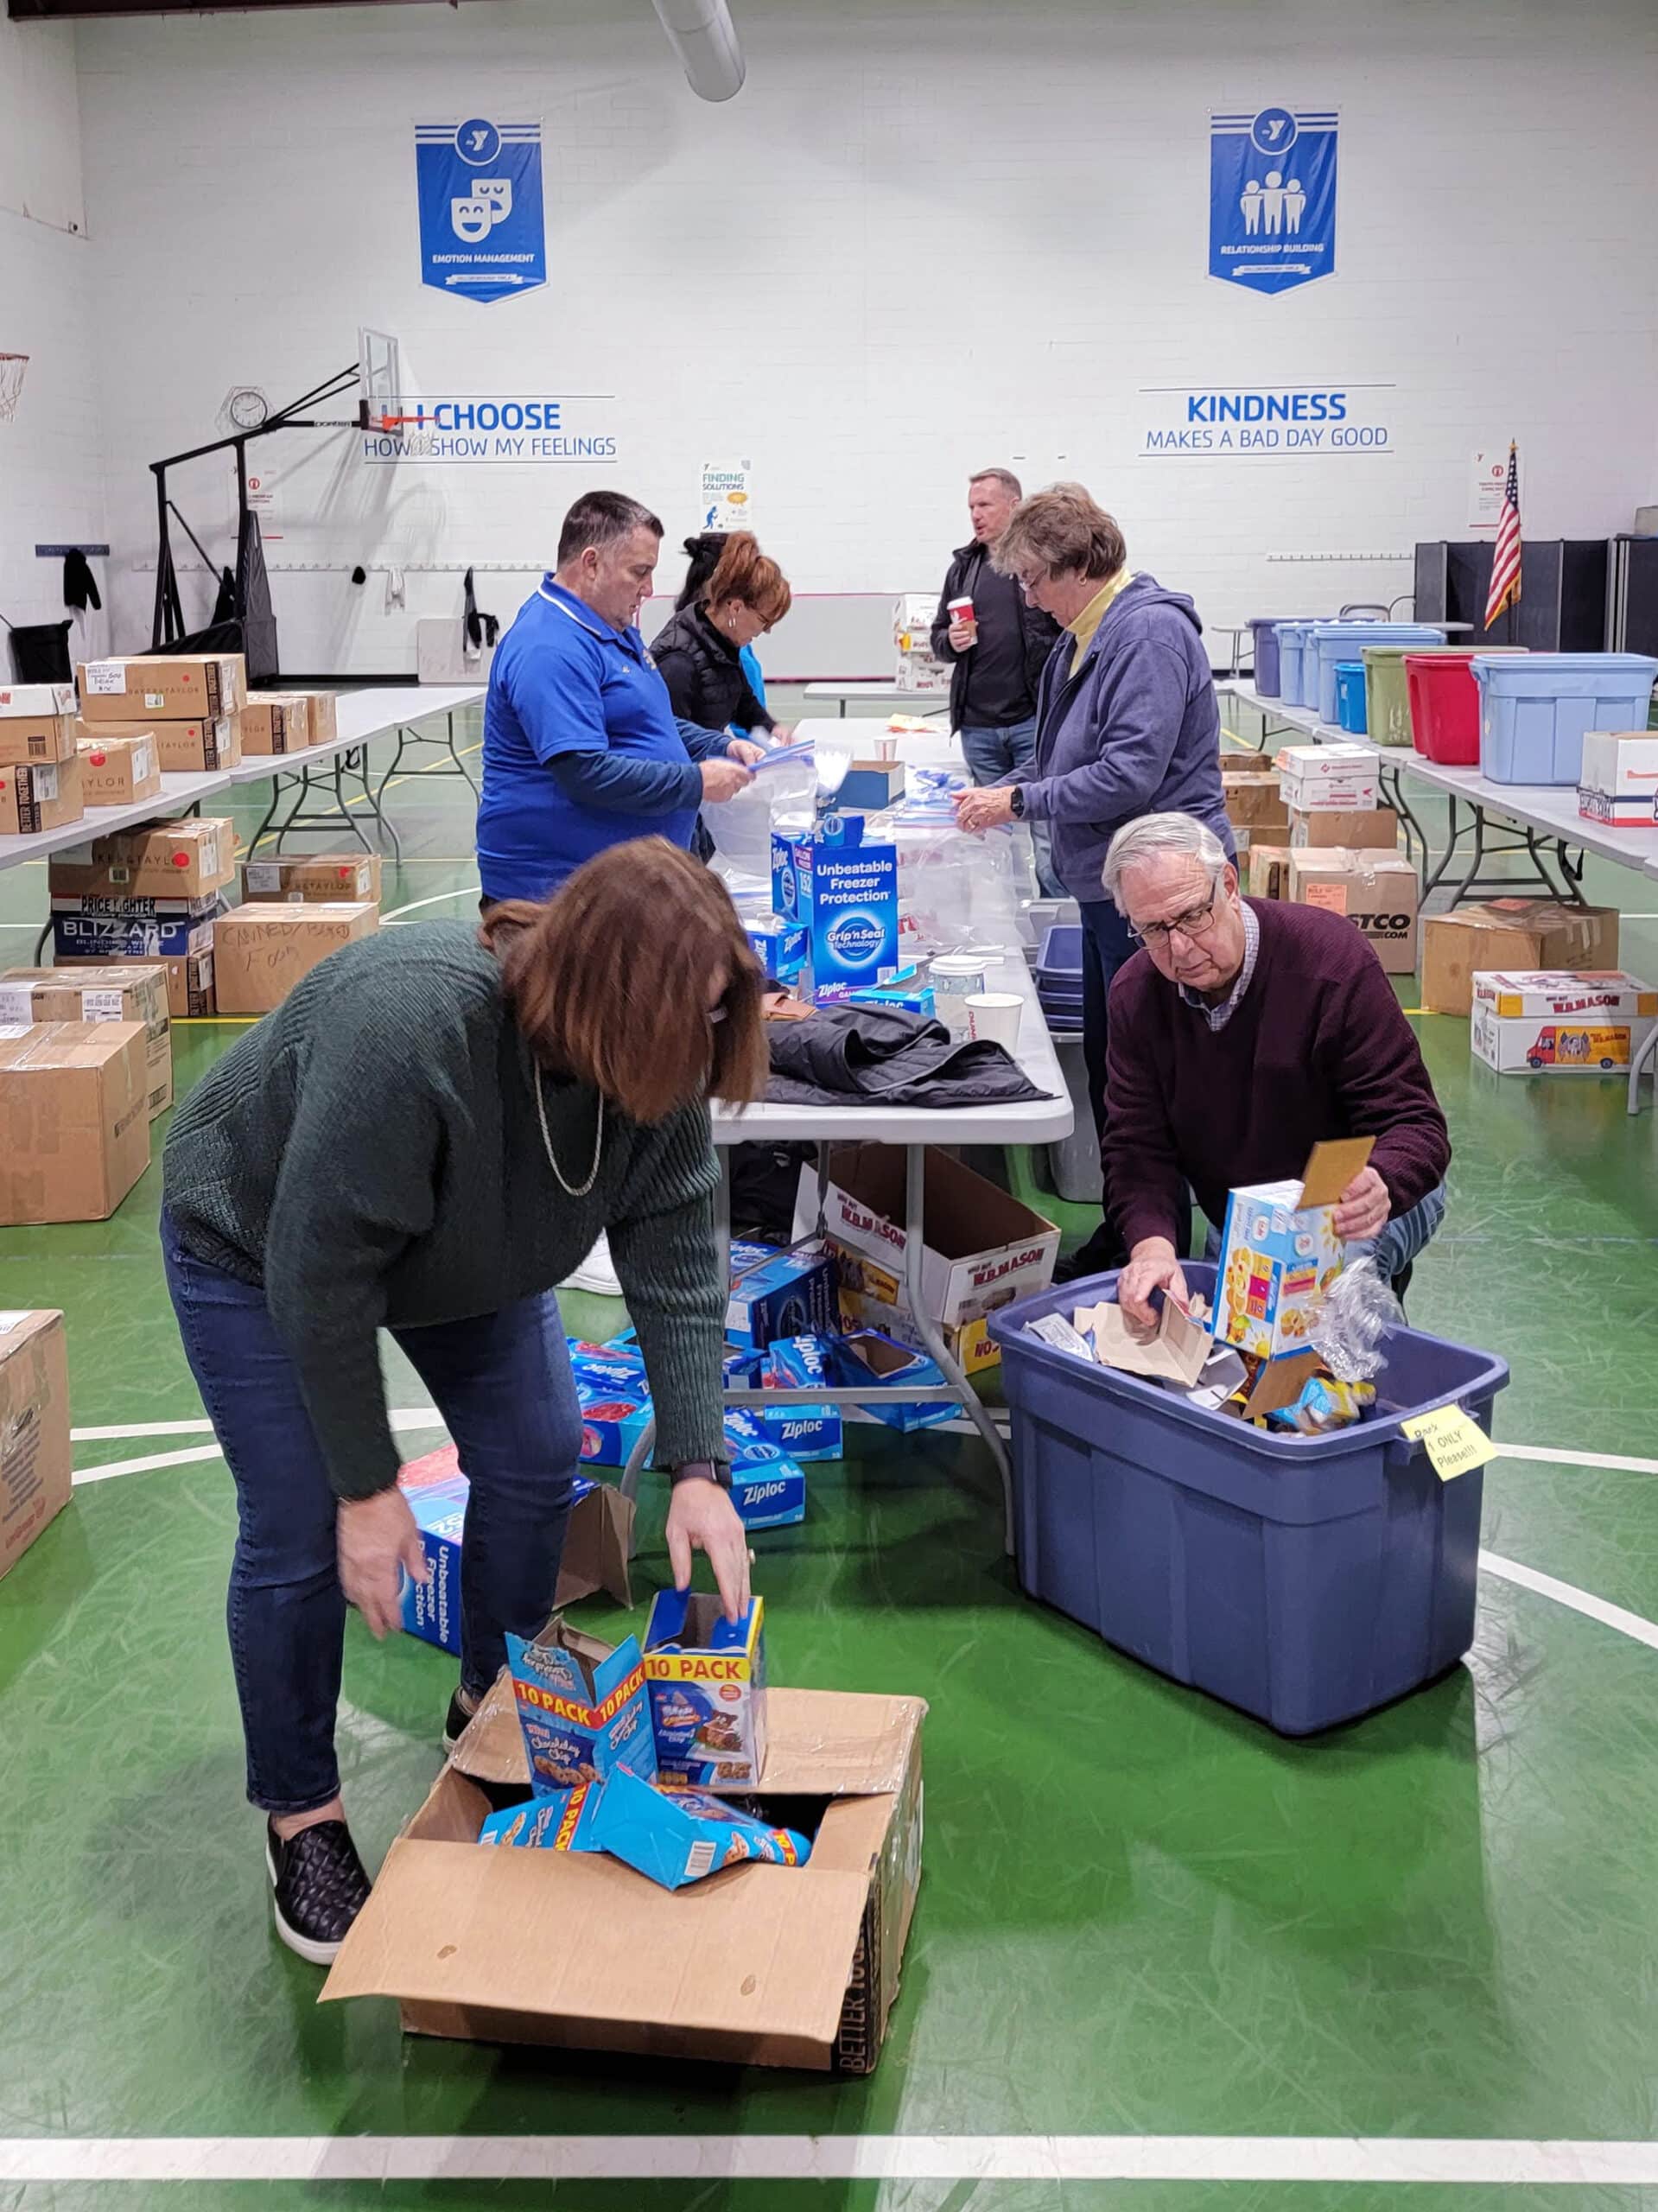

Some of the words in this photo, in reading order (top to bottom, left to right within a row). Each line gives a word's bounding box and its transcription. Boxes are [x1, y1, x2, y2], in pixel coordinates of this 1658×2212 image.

[432, 254, 473, 264] EMOTION
[473, 253, 535, 264] MANAGEMENT
[1220, 245, 1282, 255] RELATIONSHIP
[1283, 243, 1324, 253] BUILDING
[434, 403, 562, 430] CHOOSE
[1187, 394, 1347, 422] KINDNESS
[364, 437, 411, 457] HOW
[430, 438, 487, 456] SHOW
[495, 438, 524, 455] MY
[531, 437, 617, 456] FEELINGS
[1146, 429, 1213, 448] MAKES
[1218, 430, 1233, 448] A
[1240, 429, 1280, 448] BAD
[1286, 429, 1325, 447] DAY
[1331, 427, 1388, 446] GOOD
[702, 473, 745, 483] FINDING
[816, 861, 893, 876] Unbeatable
[829, 876, 880, 889] Freezer
[63, 919, 178, 938] BLIZZARD
[781, 1420, 823, 1440] Ziploc
[1437, 1430, 1463, 1448] ONLY
[743, 1481, 786, 1506] Ziploc
[438, 1545, 449, 1644] Unbeatable
[647, 1659, 670, 1677] 10
[679, 1659, 742, 1680] PACK
[599, 1702, 614, 1722] 10
[614, 1667, 645, 1708] PACK
[518, 1684, 539, 1705] 10
[542, 1694, 591, 1726] PACK
[569, 1785, 586, 1805] 10
